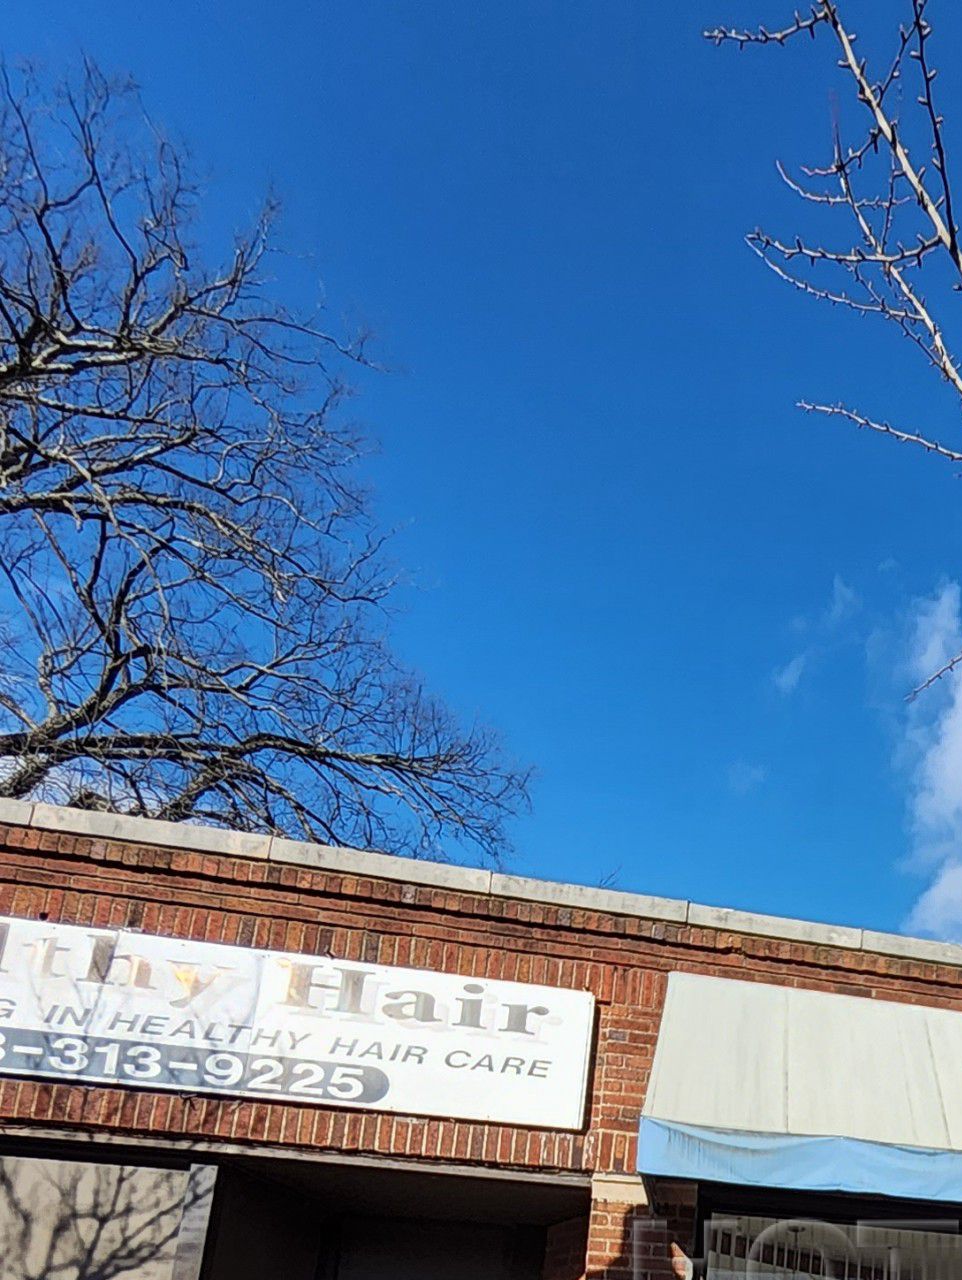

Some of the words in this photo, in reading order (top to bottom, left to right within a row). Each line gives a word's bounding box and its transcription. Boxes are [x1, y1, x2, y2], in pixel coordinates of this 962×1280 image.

[275, 957, 550, 1036] Hair
[0, 1032, 364, 1100] -313-9225
[44, 1004, 92, 1027] IN
[108, 1012, 312, 1050] HEALTHY
[328, 1037, 428, 1065] HAIR
[444, 1050, 553, 1078] CARE
